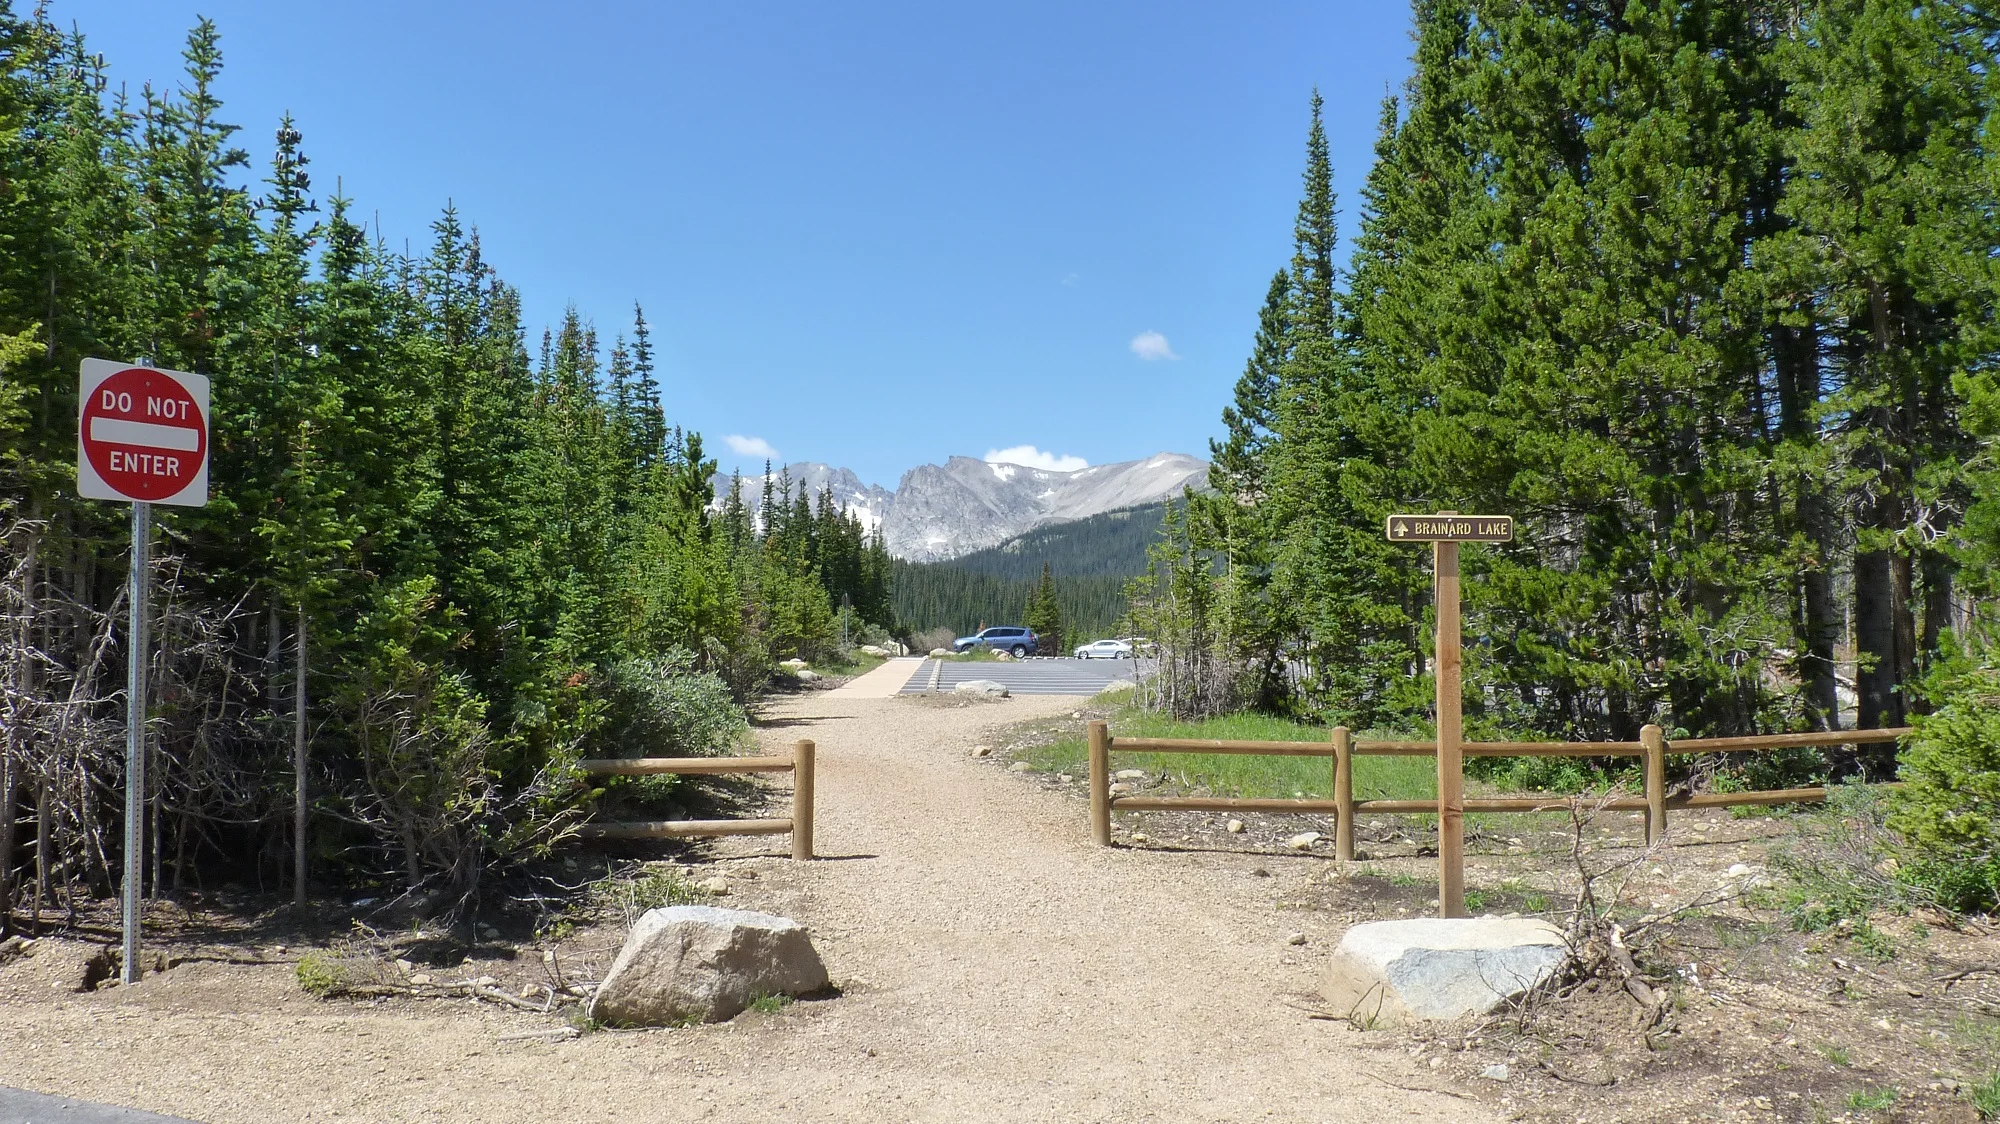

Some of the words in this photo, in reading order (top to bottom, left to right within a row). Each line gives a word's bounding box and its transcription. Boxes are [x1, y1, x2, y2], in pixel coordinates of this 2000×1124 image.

[102, 389, 132, 413] DO
[147, 396, 190, 420] NOT
[110, 451, 179, 477] ENTER
[1415, 522, 1472, 535] BRAINARD
[1478, 522, 1508, 535] LAKE
